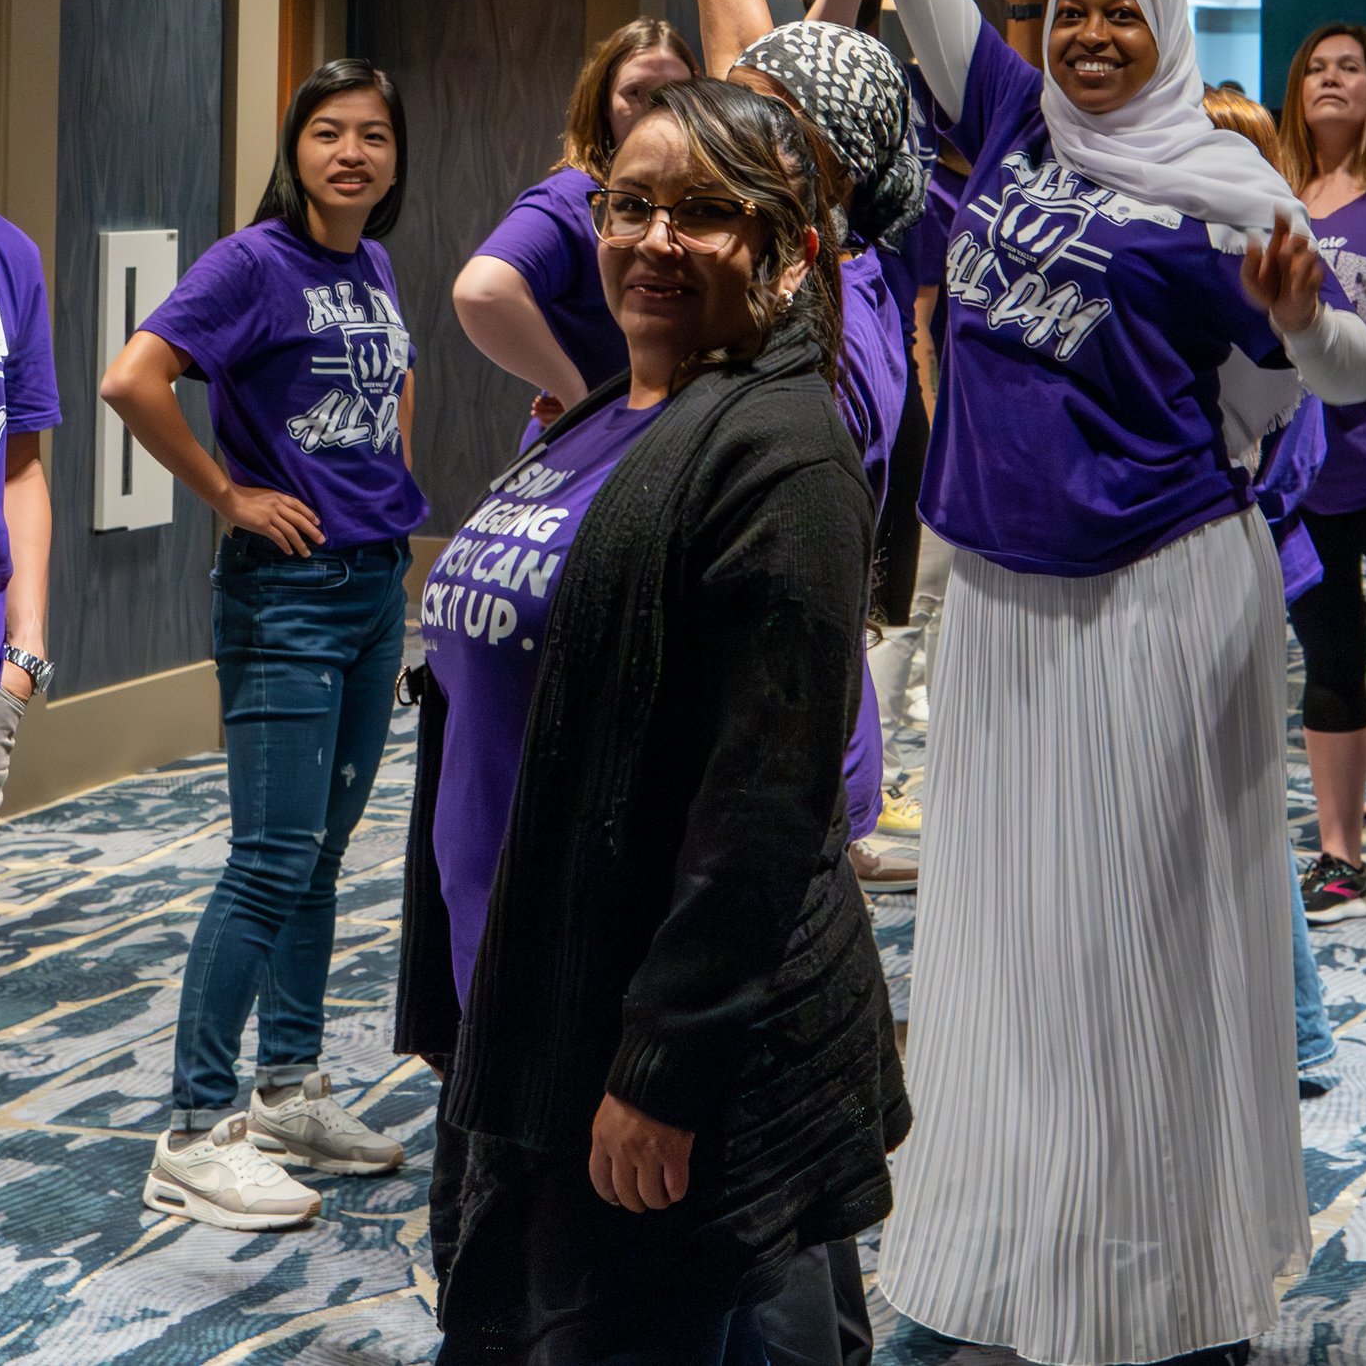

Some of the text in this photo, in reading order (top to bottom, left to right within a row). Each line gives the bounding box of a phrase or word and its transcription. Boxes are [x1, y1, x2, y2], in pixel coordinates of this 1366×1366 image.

[303, 281, 368, 334] ALL
[987, 270, 1113, 363] DAY
[286, 388, 372, 454] ALL
[434, 535, 562, 599] YOU CAN
[446, 585, 467, 632] IT
[463, 589, 535, 652] UP.
